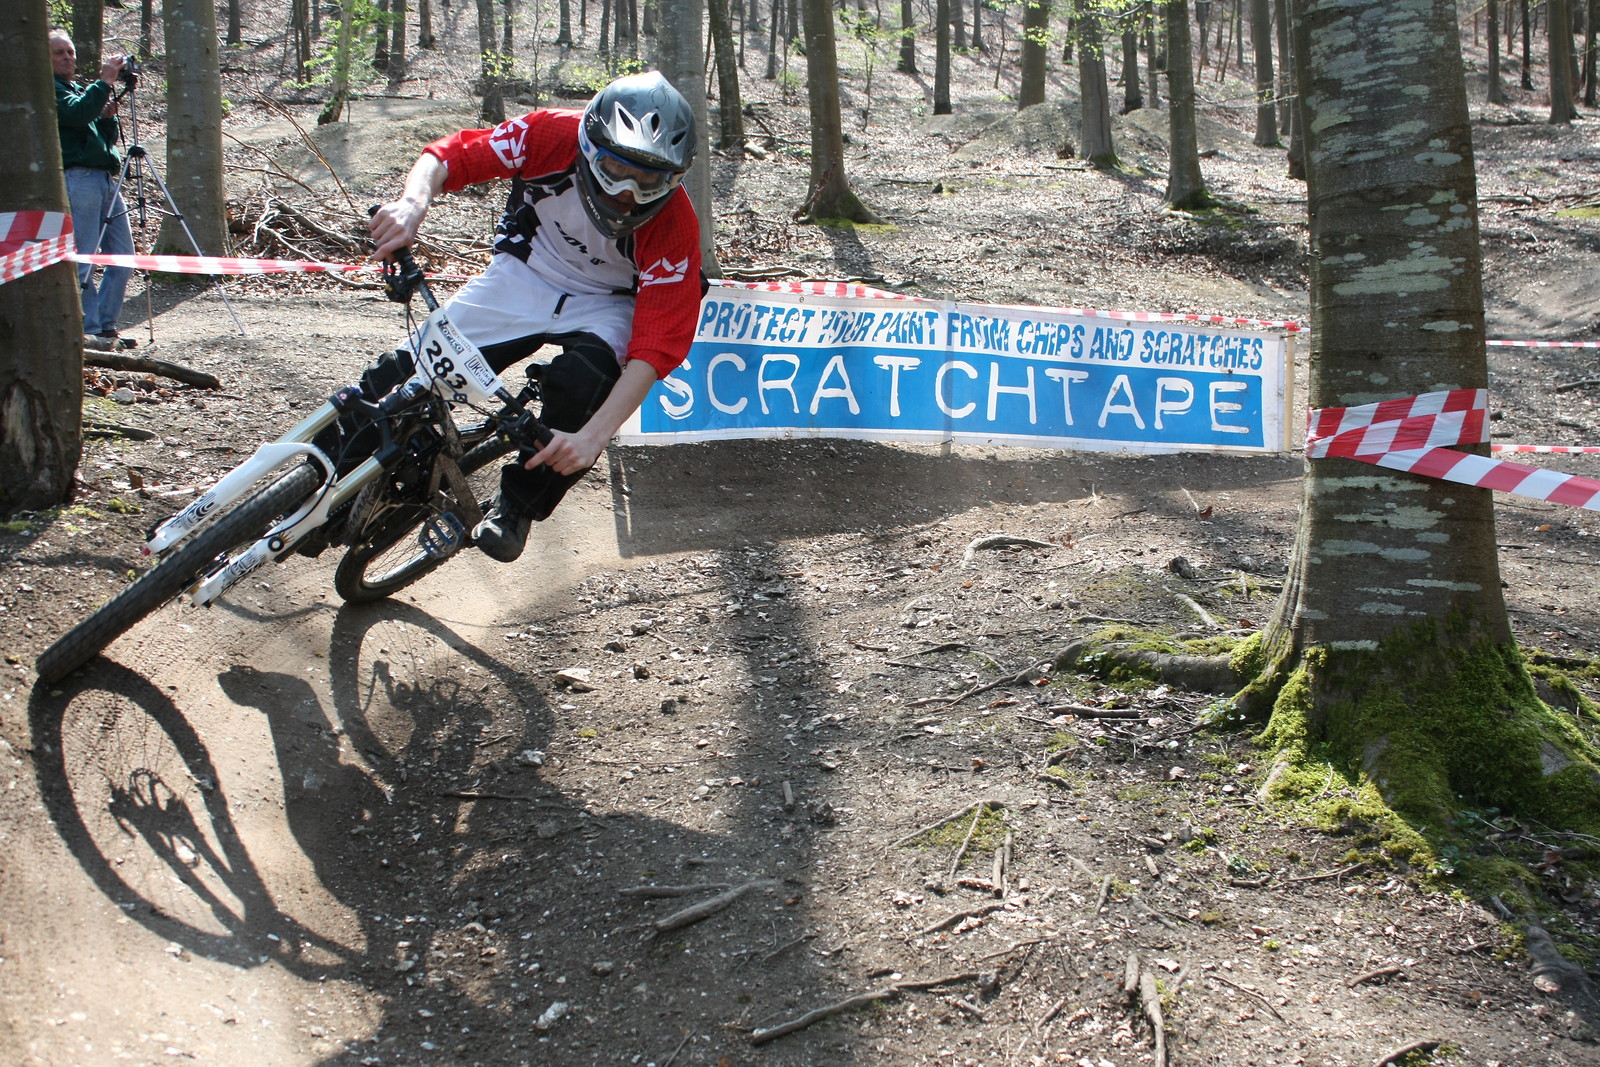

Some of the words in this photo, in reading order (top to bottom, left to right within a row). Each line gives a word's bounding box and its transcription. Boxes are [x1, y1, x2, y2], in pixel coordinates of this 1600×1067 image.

[426, 340, 467, 389] 283
[699, 301, 813, 343] PROTECT
[818, 309, 874, 345] YOUR
[872, 310, 939, 345] PAINT
[947, 312, 1011, 352] FROM
[1016, 321, 1085, 358] CHIPS
[1089, 328, 1135, 361] AND
[1140, 330, 1264, 371] SCRATCHES
[467, 358, 482, 375] UK
[660, 353, 1251, 434] SCRATCHTAPE
